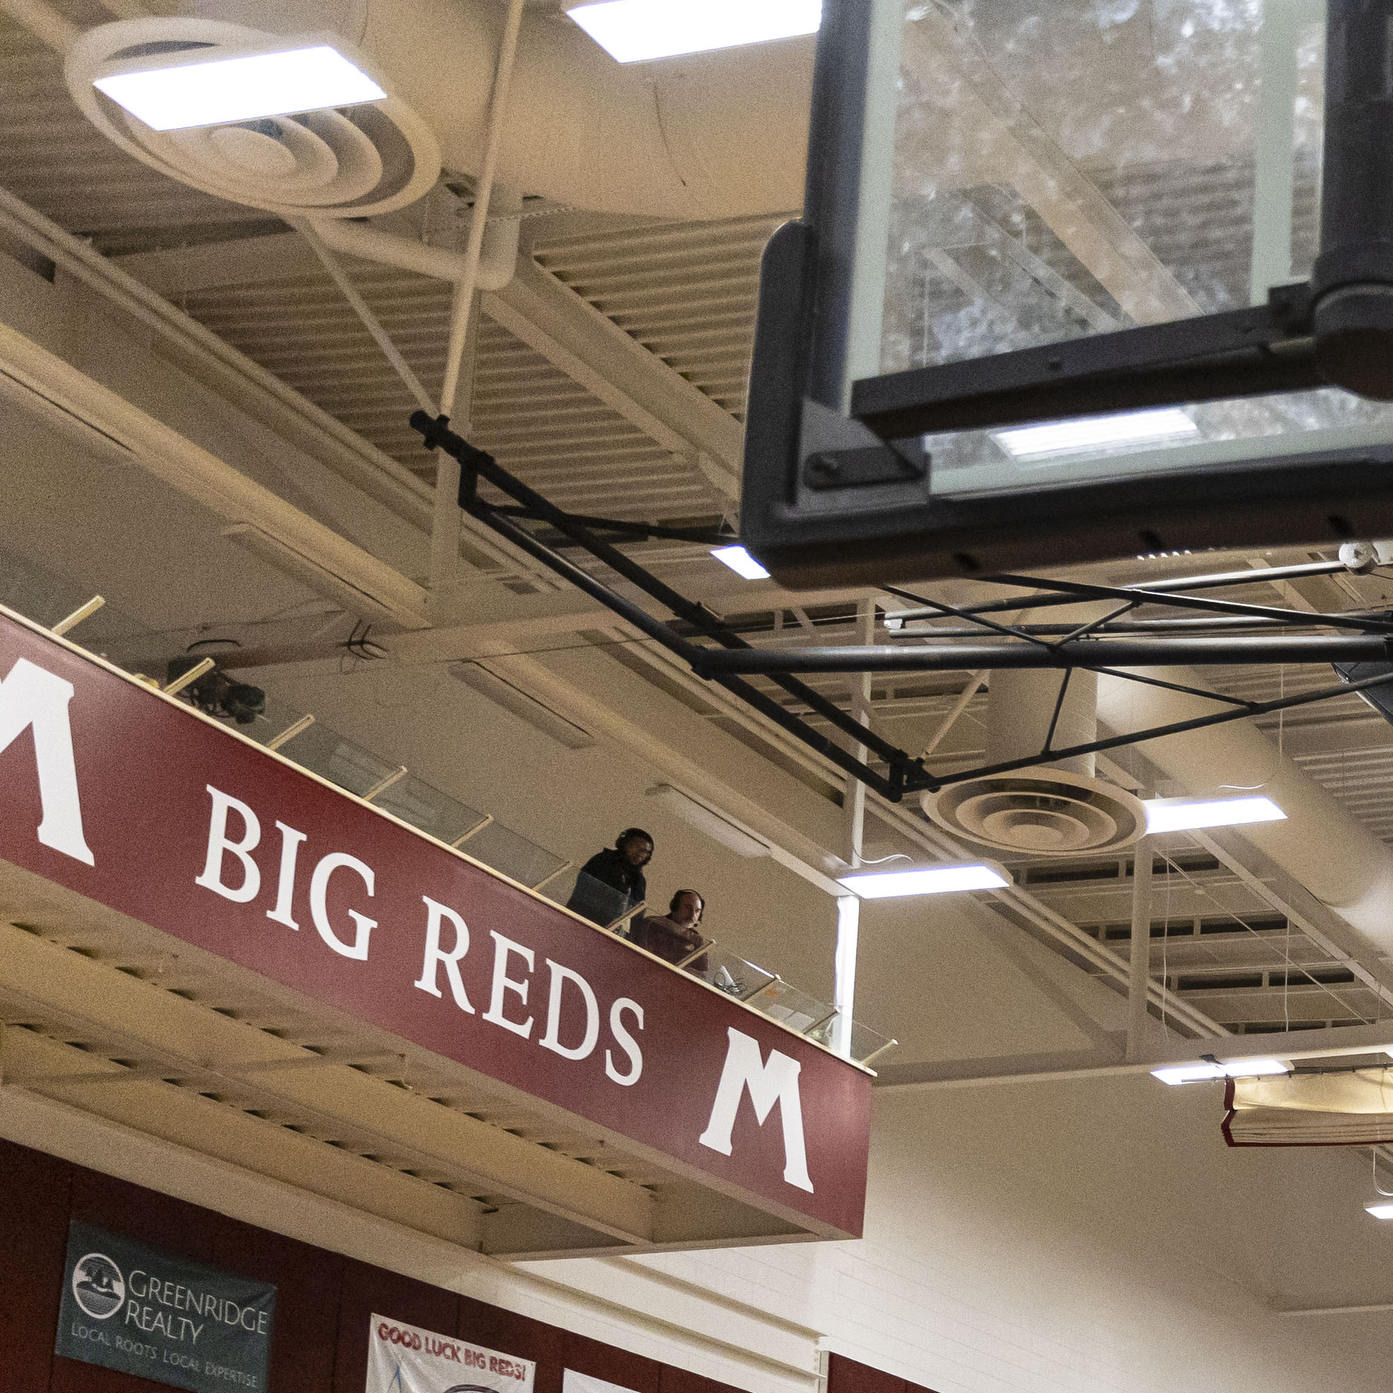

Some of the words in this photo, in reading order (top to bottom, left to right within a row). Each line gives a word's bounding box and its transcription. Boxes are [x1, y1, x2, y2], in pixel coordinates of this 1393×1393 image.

[195, 784, 378, 962] BIG
[414, 895, 645, 1087] REDS
[699, 1025, 814, 1194] M
[124, 1300, 204, 1346] REALTY
[128, 1270, 269, 1335] GREENRIDGE
[71, 1323, 111, 1346] LOCAL
[115, 1335, 158, 1360] ROOTS
[162, 1349, 200, 1373] LOCAL
[205, 1361, 257, 1388] EXPERTISE
[378, 1322, 422, 1350] GOOD
[424, 1336, 462, 1364] LUCK
[464, 1350, 486, 1370] BIG
[489, 1356, 526, 1382] REDS!
